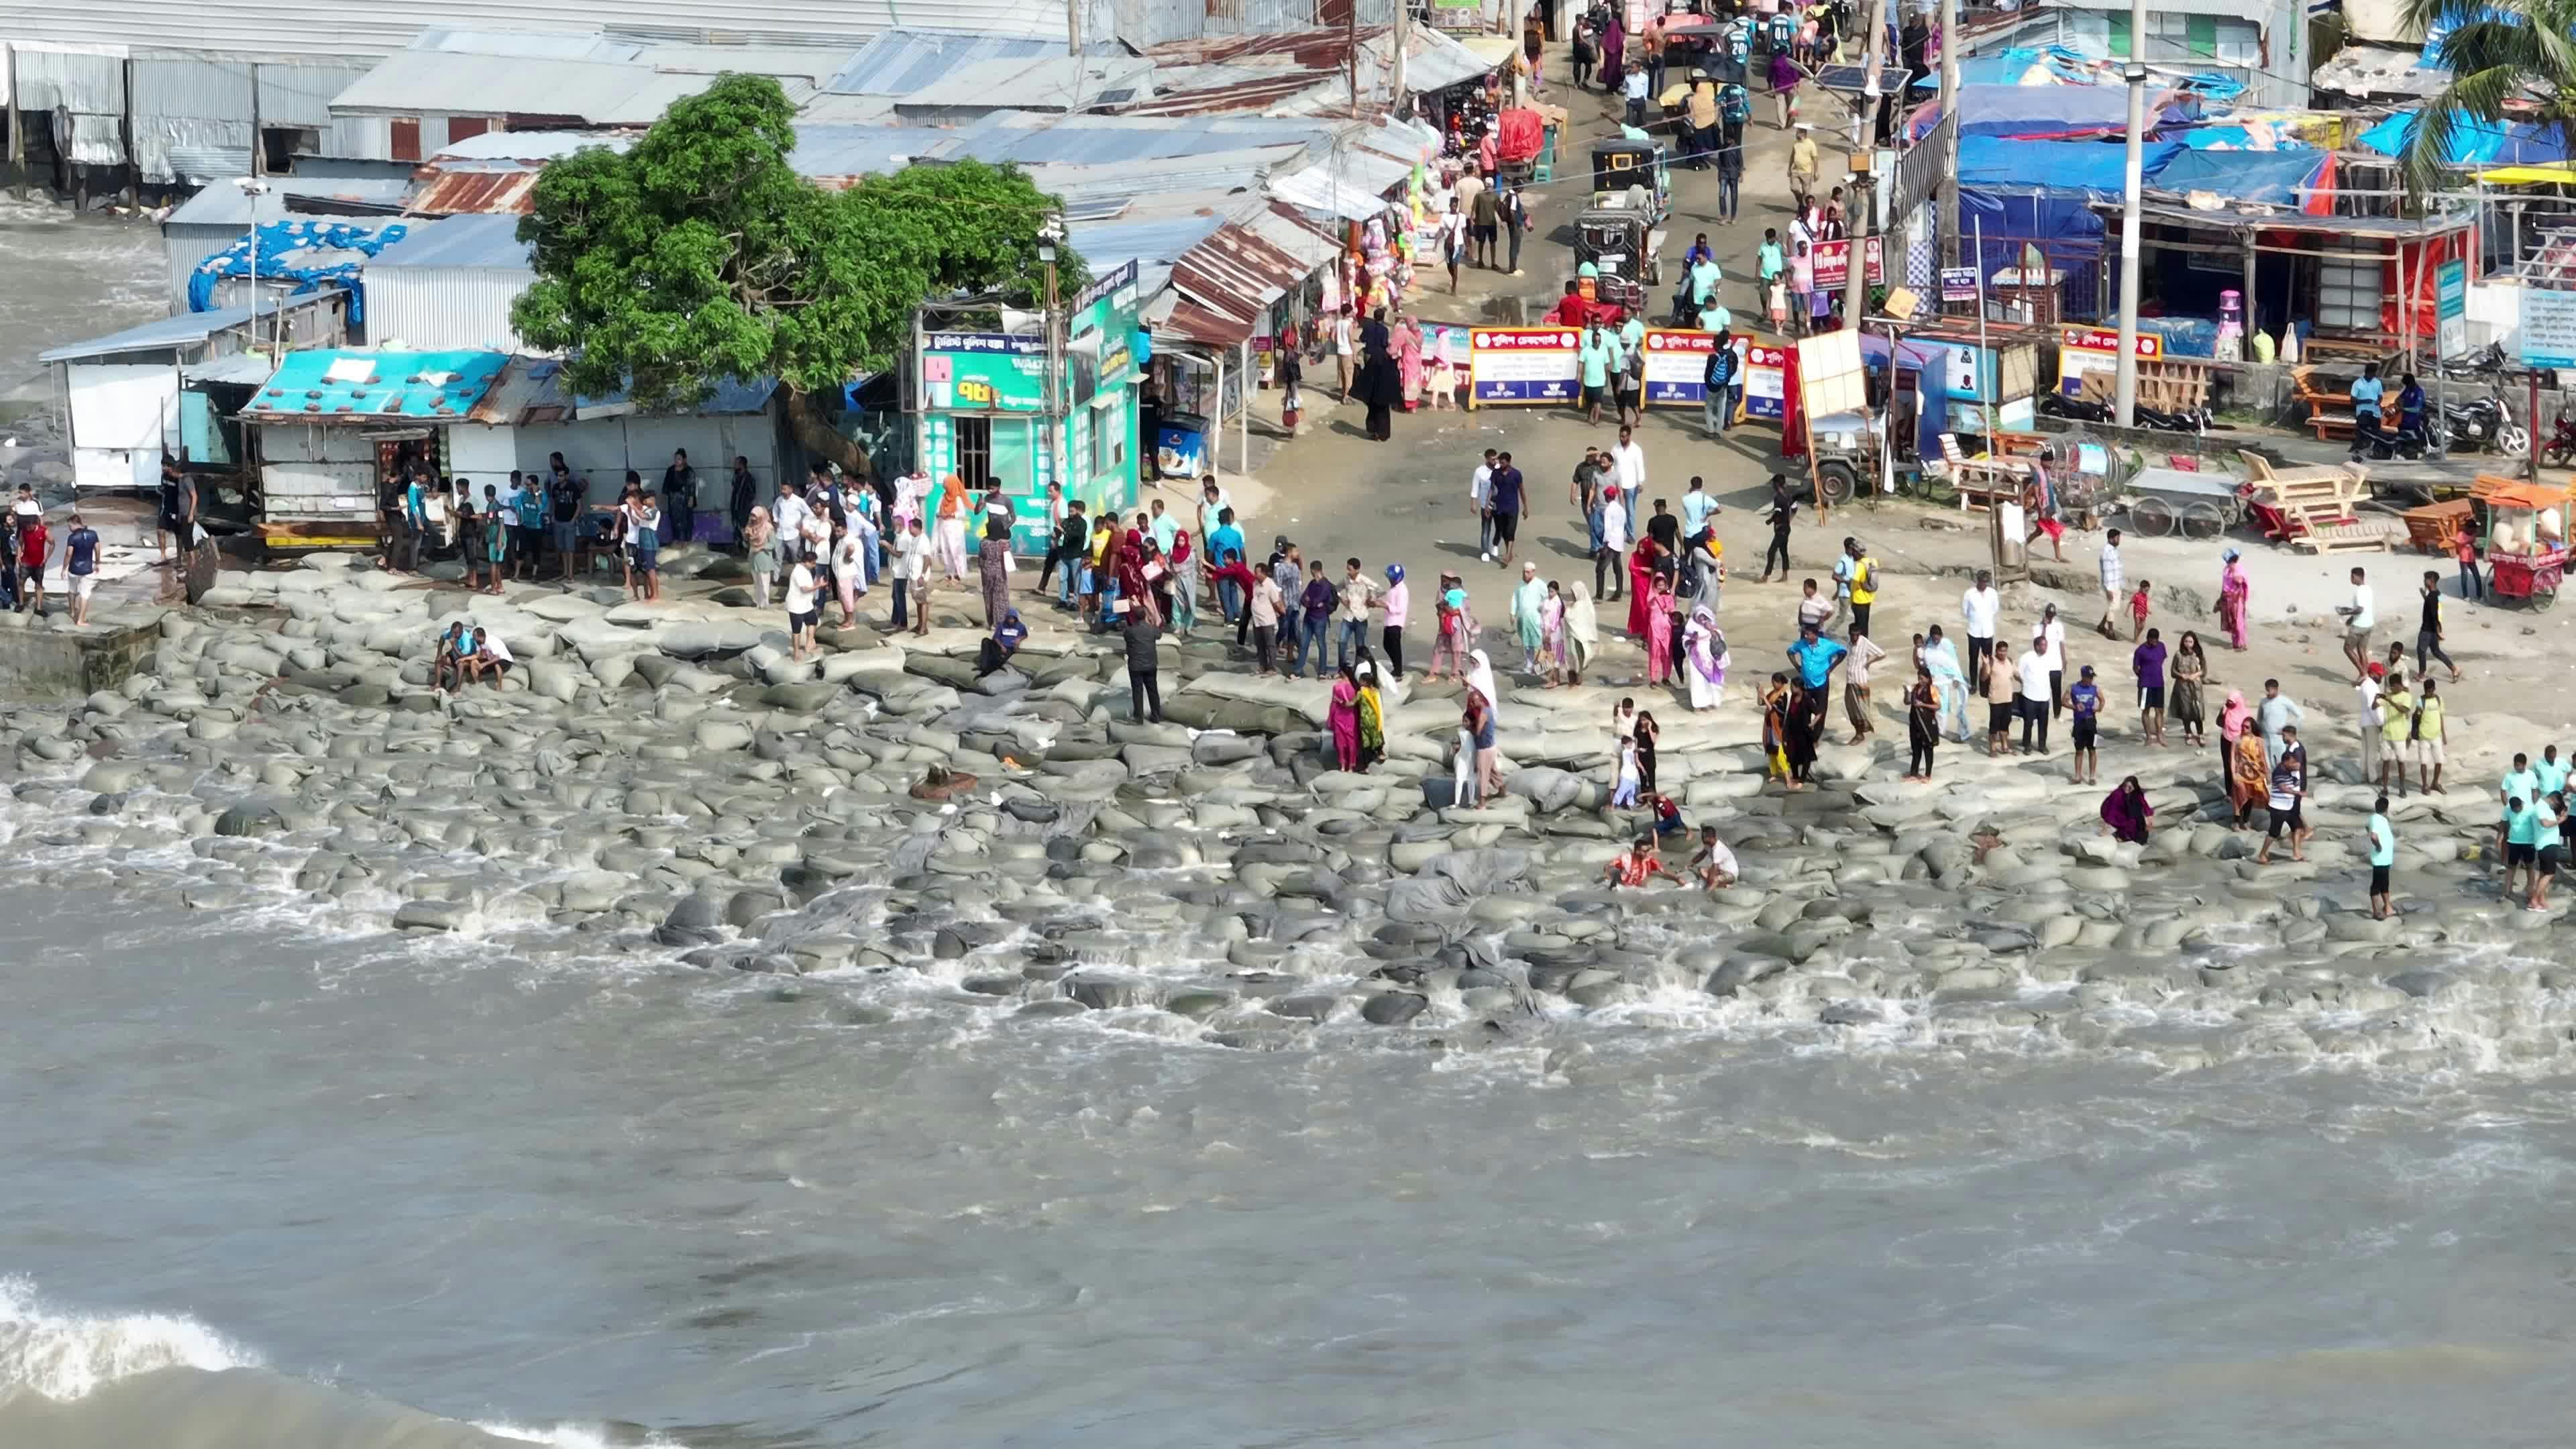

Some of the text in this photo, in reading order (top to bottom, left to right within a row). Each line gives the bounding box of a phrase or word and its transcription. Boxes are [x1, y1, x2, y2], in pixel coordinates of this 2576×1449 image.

[963, 336, 986, 350] পুলিশ
[1491, 334, 1515, 347] পুলিশ
[1666, 335, 1689, 348] পুলিশ
